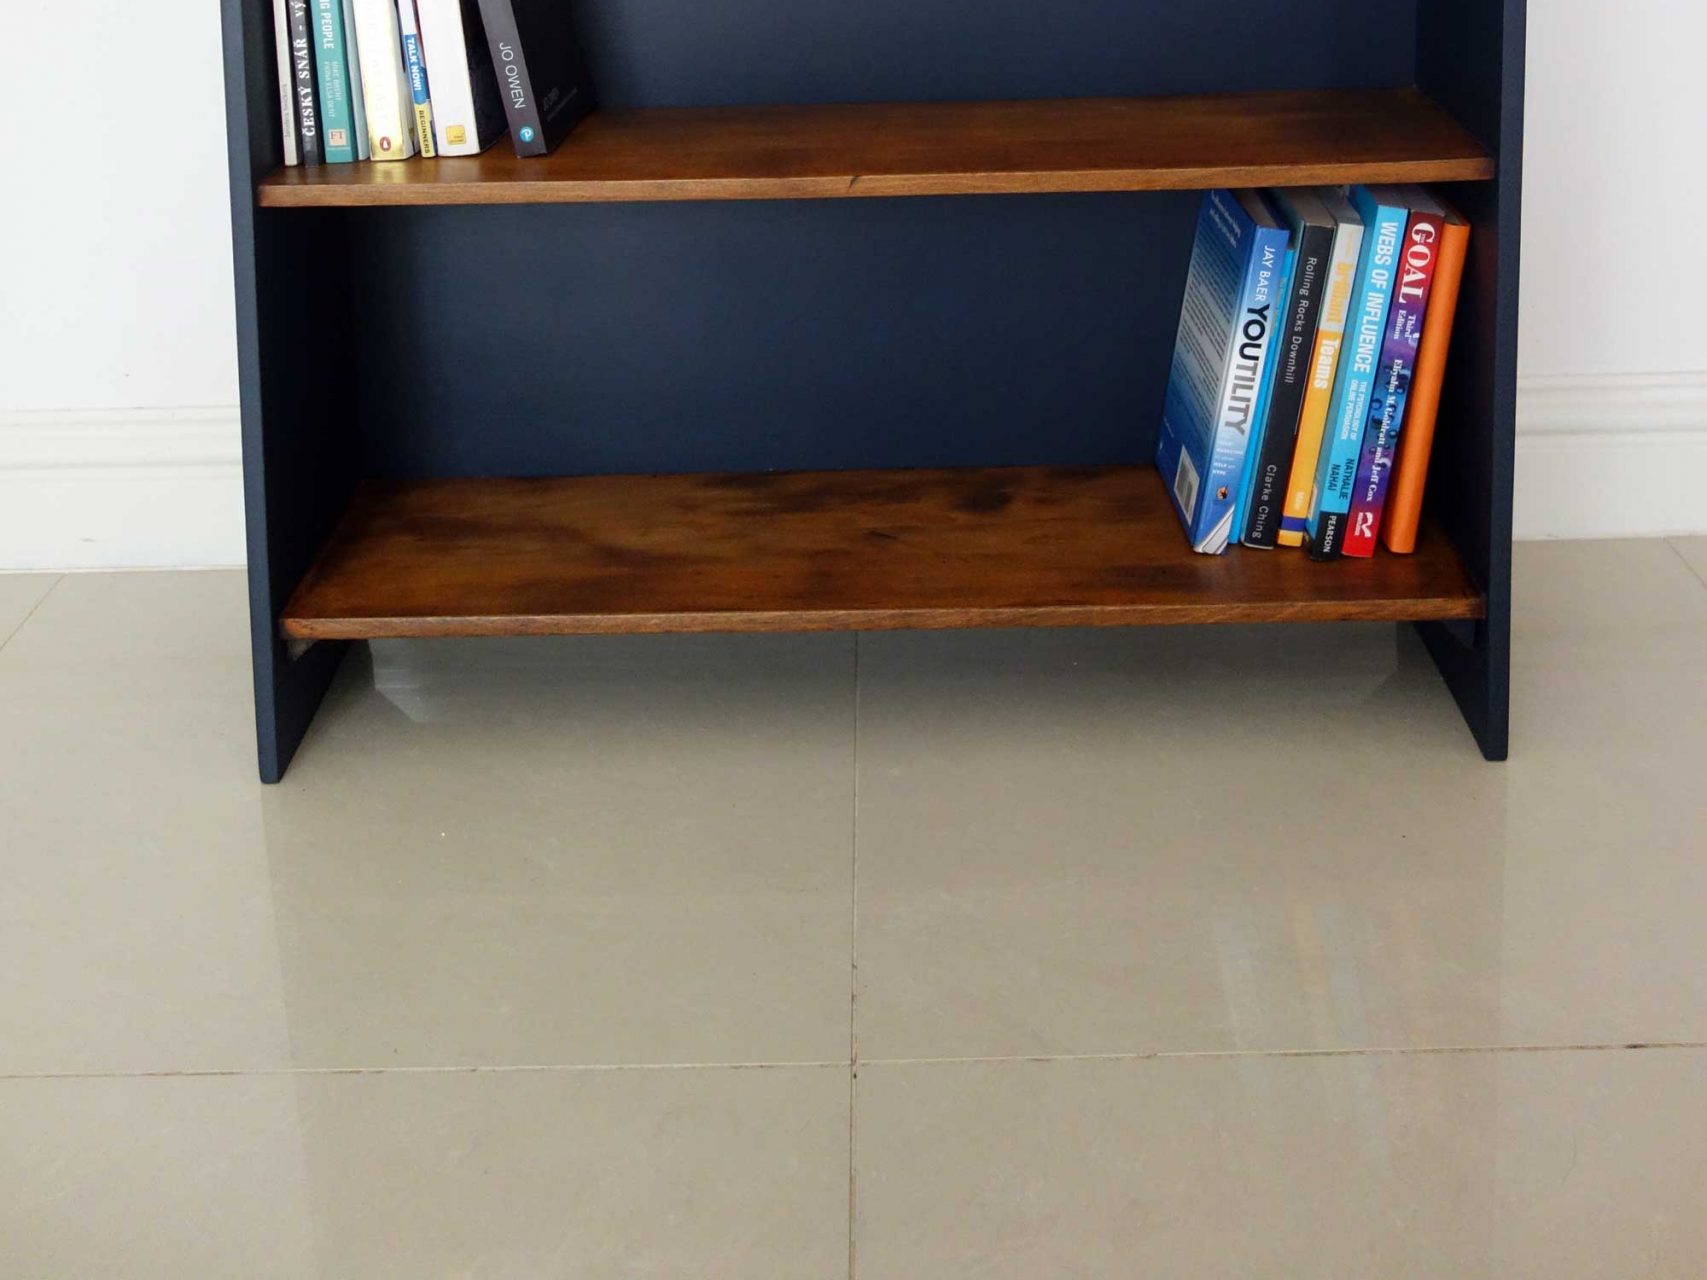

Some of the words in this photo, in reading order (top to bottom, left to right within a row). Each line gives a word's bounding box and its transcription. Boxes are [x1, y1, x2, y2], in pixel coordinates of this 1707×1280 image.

[321, 11, 334, 49] PEOPLE
[294, 37, 310, 79] SNÁŘ
[406, 37, 417, 63] TALK
[499, 42, 513, 61] JO
[411, 65, 421, 91] NOW!
[505, 64, 527, 109] OWEN
[298, 86, 315, 136] ČESKÝ
[330, 131, 343, 140] FT
[418, 110, 430, 154] BEGINNERS
[1261, 245, 1276, 268] JAY
[1374, 221, 1399, 266] WEBS
[1398, 221, 1435, 304] GOAL
[1254, 271, 1271, 302] BAER
[1298, 256, 1317, 297] Rolling
[1370, 269, 1389, 289] OF
[1293, 299, 1310, 332] Rocks
[1354, 292, 1384, 374] INFLUENCE
[1393, 309, 1407, 340] Edition
[1405, 314, 1417, 338] Third
[1225, 303, 1270, 436] YOUTILITY
[1284, 336, 1302, 384] Downhill
[1314, 338, 1338, 390] Teams
[1378, 406, 1393, 445] Goldratt
[1369, 465, 1381, 485] Jeff
[1372, 447, 1384, 466] and
[1261, 464, 1277, 502] Clarke
[1328, 463, 1341, 491] NAHAI
[1339, 458, 1355, 500] NATHALIE
[1366, 484, 1377, 502] Cox
[1252, 505, 1269, 539] Ching
[1323, 515, 1337, 553] PEARSON
